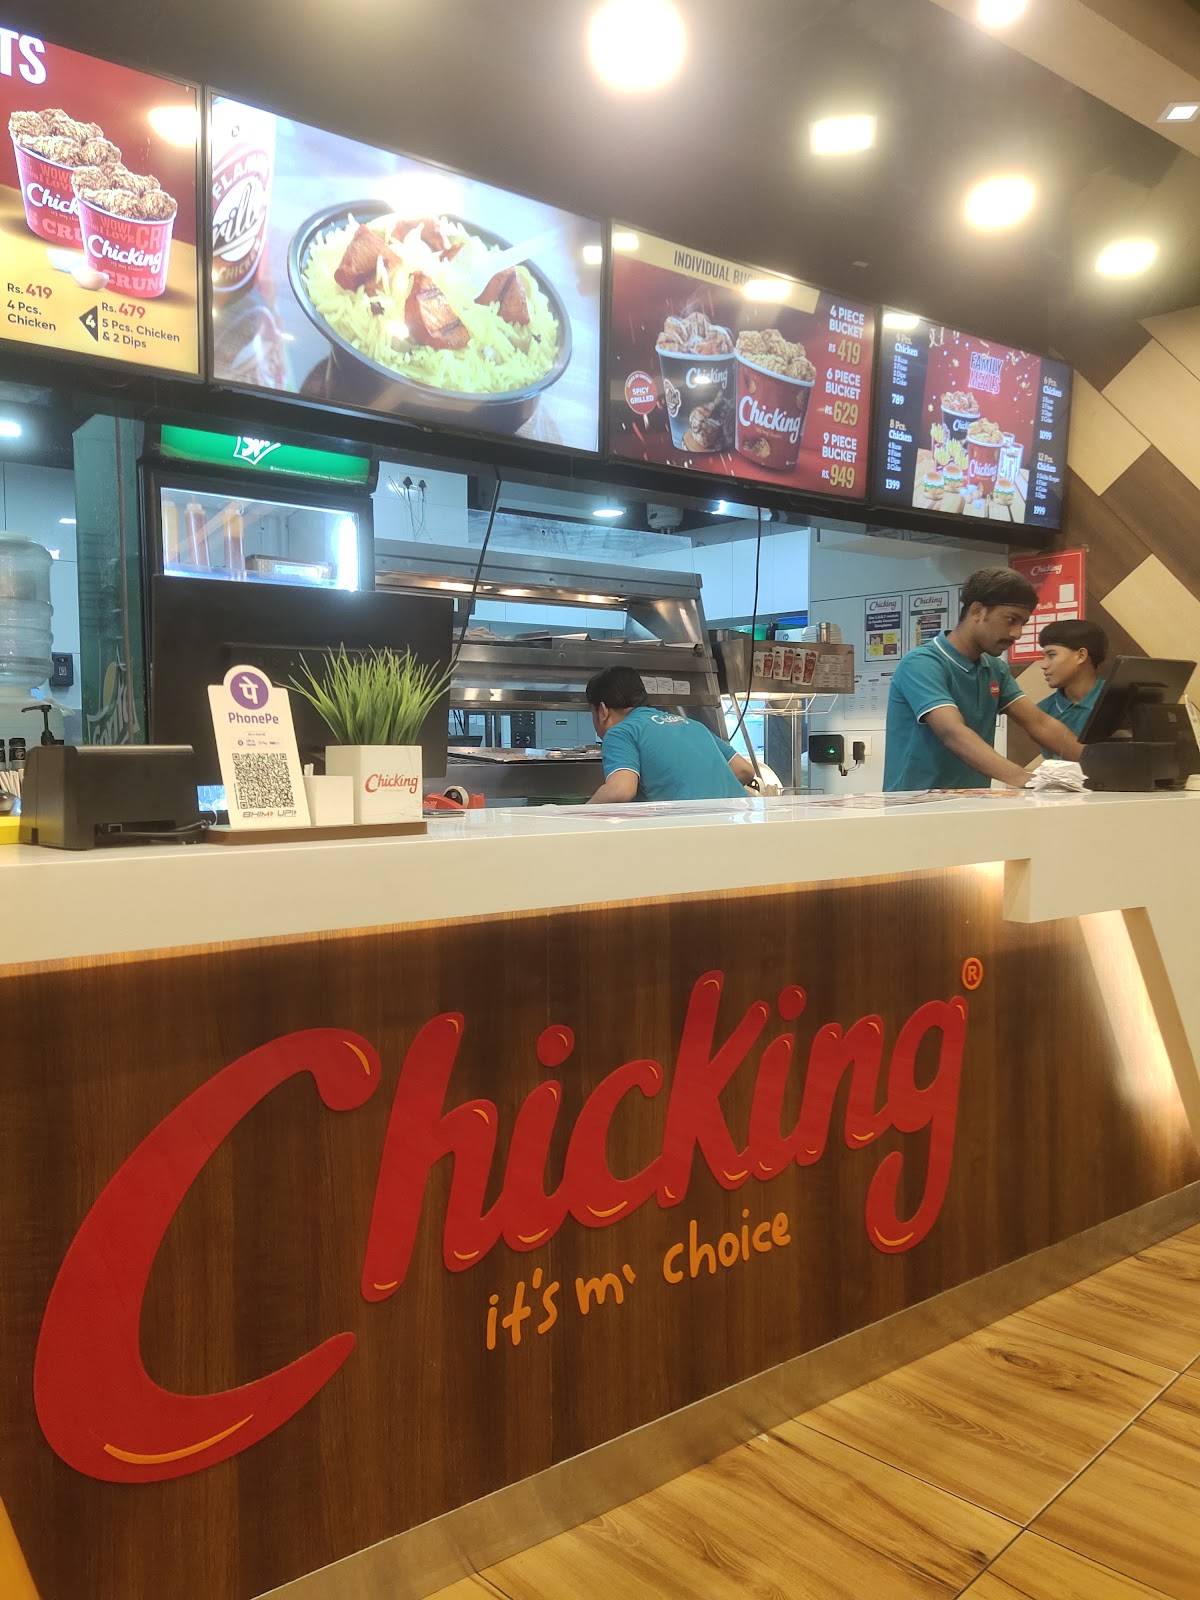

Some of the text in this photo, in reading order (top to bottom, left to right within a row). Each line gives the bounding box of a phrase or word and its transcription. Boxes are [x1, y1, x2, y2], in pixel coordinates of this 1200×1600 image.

[88, 234, 163, 274] Chicking
[674, 250, 731, 282] INDIVIDUAL
[8, 283, 52, 299] Rs. 419
[7, 300, 42, 315] 4 Pcs.
[102, 302, 146, 319] Rs. 479
[830, 304, 864, 326] 4 PIECE
[8, 313, 56, 332] Chicken
[85, 314, 96, 329] 4
[102, 318, 181, 343] 5 Pcs. Chicken
[829, 318, 864, 339] BUCKET
[102, 331, 147, 349] & 2 Dips
[837, 339, 861, 365] 419
[826, 367, 861, 387] 6 PIECE
[825, 380, 861, 400] BUCKET
[738, 395, 801, 444] Chicking
[833, 400, 859, 426] 629
[823, 432, 858, 451] 9 PIECE
[822, 445, 857, 464] BUCKET
[830, 463, 856, 489] 949
[228, 711, 279, 726] PhonePe
[365, 773, 420, 794] Chicking
[33, 970, 969, 1483] Chicking
[486, 1266, 561, 1351] it's
[662, 1208, 792, 1285] choice
